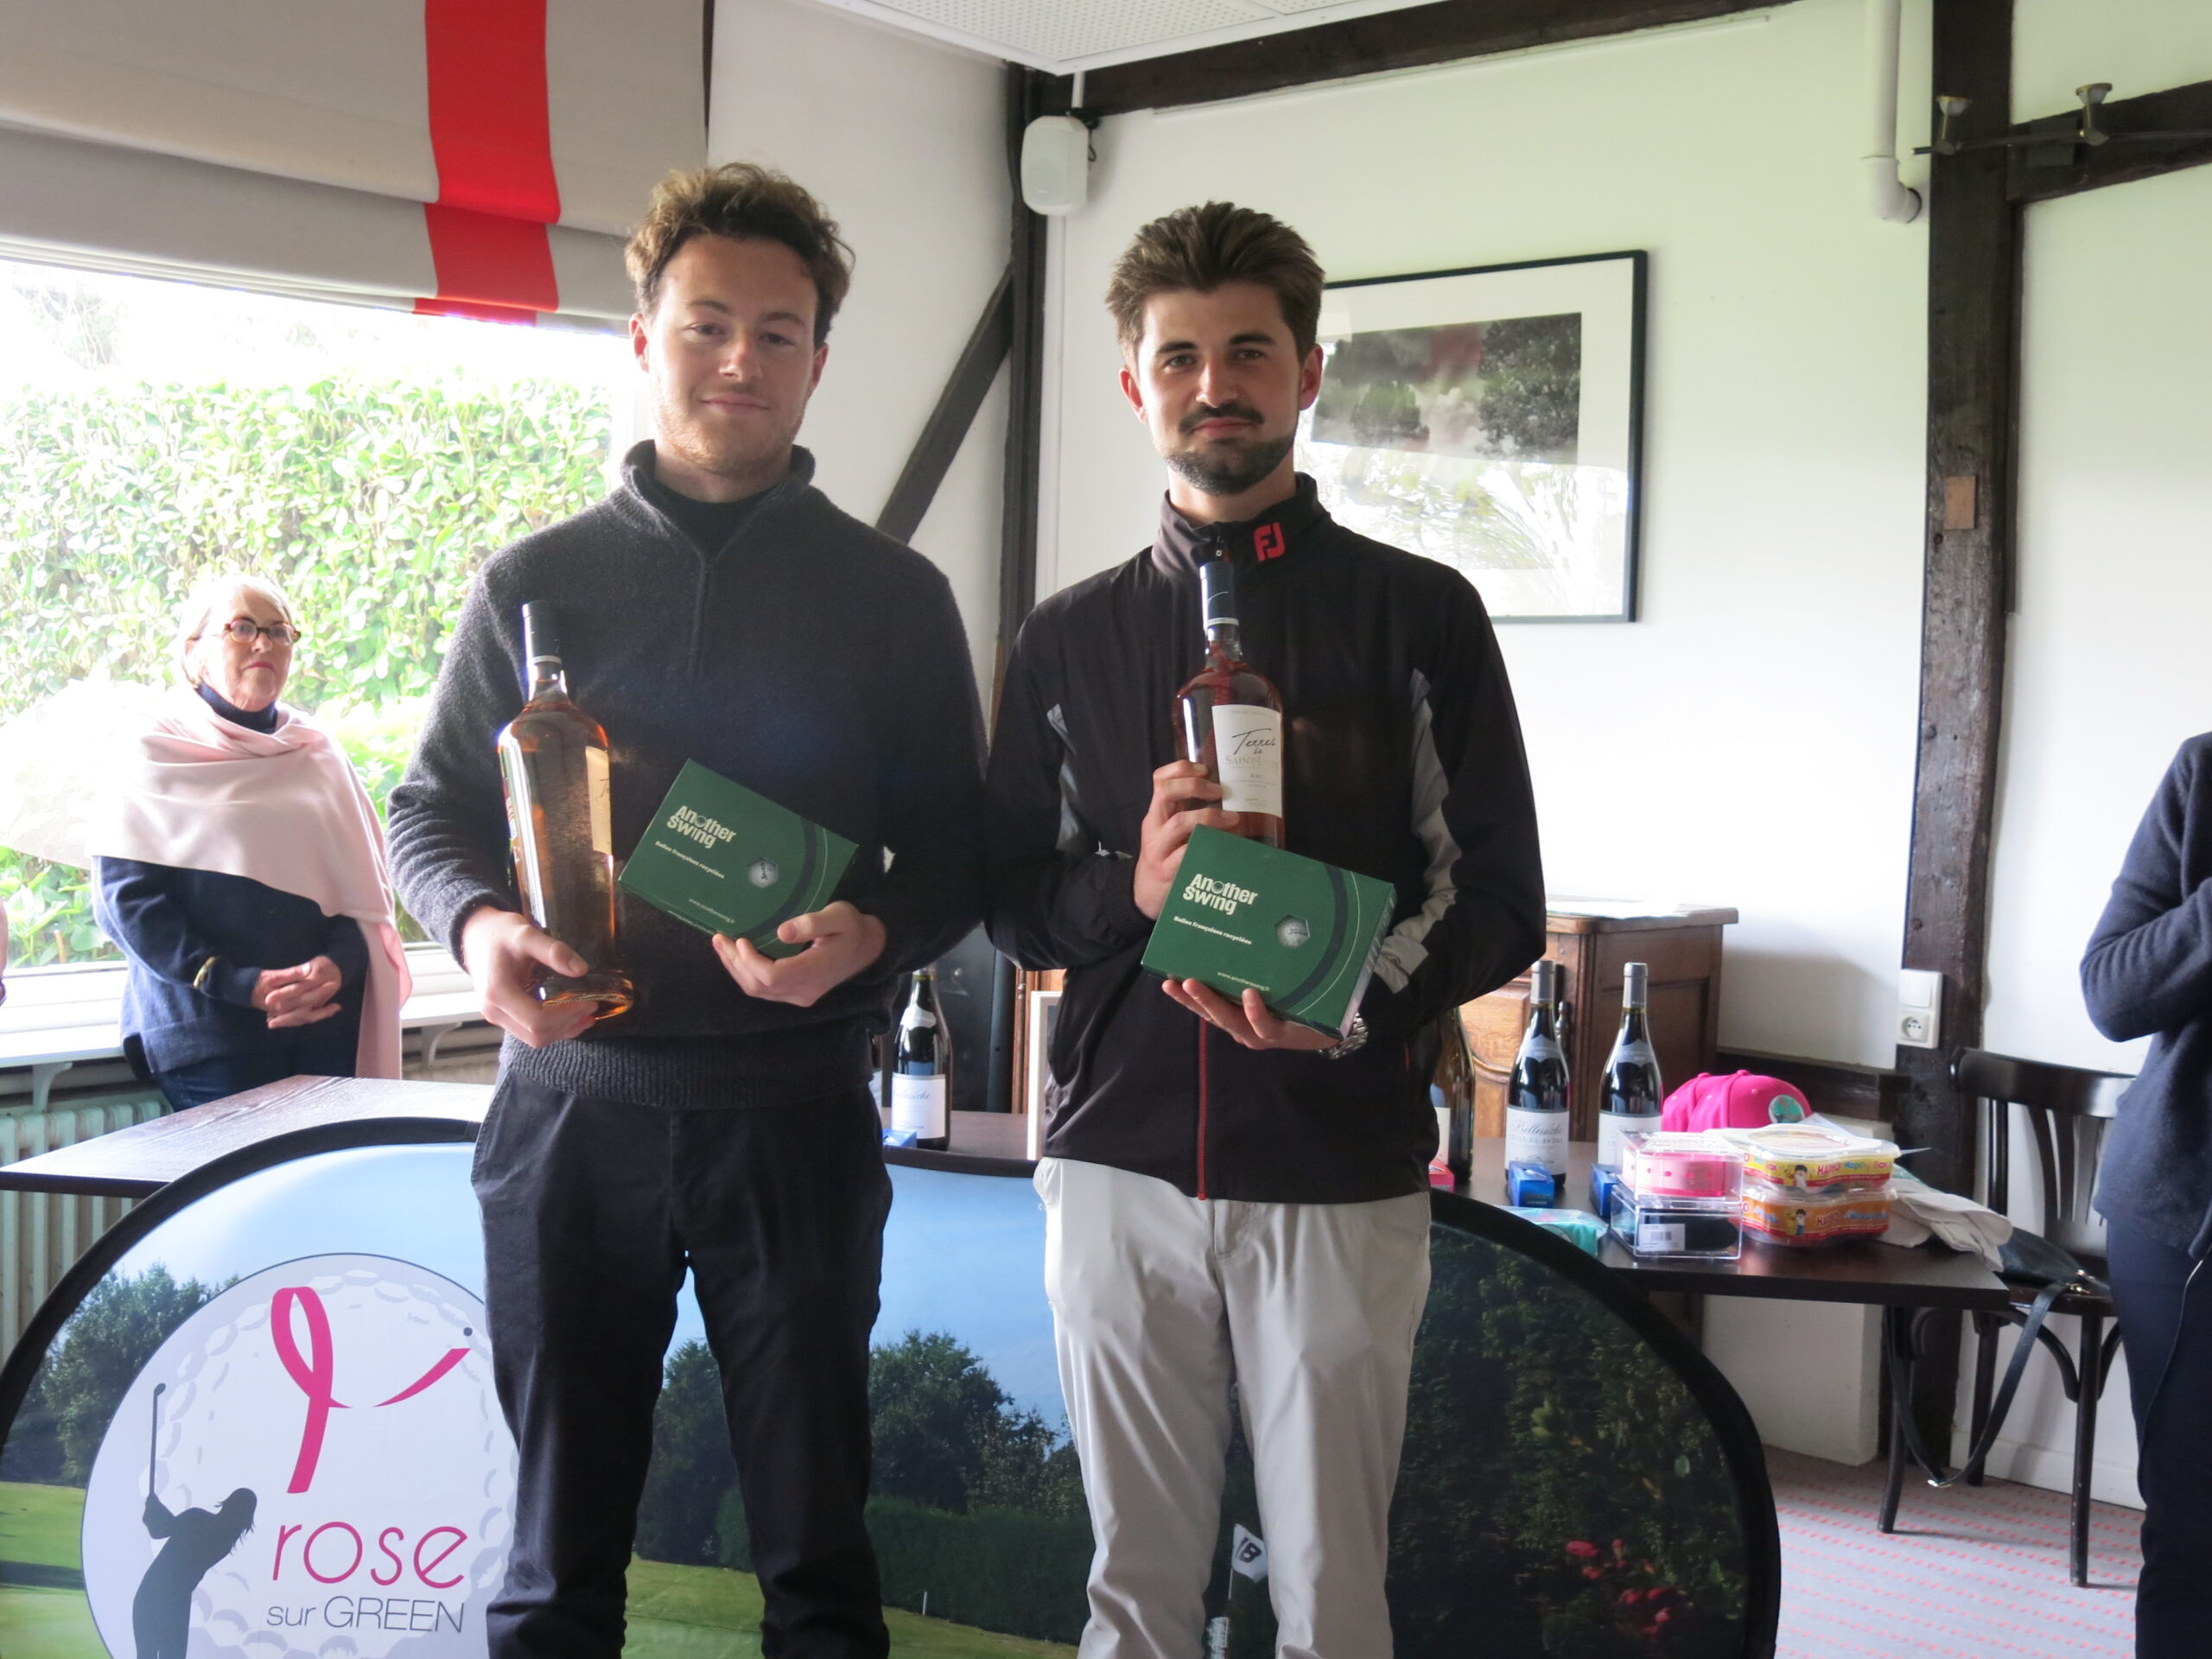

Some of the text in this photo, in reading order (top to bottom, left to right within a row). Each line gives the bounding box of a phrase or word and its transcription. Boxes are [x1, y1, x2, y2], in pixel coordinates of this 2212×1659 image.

[1253, 521, 1286, 562] FJ
[666, 815, 716, 849] Swing
[675, 804, 736, 842] Another
[1182, 886, 1237, 916] Swing
[1190, 873, 1258, 906] Another
[270, 1520, 469, 1590] rose
[265, 1595, 466, 1634] sur GREEN
